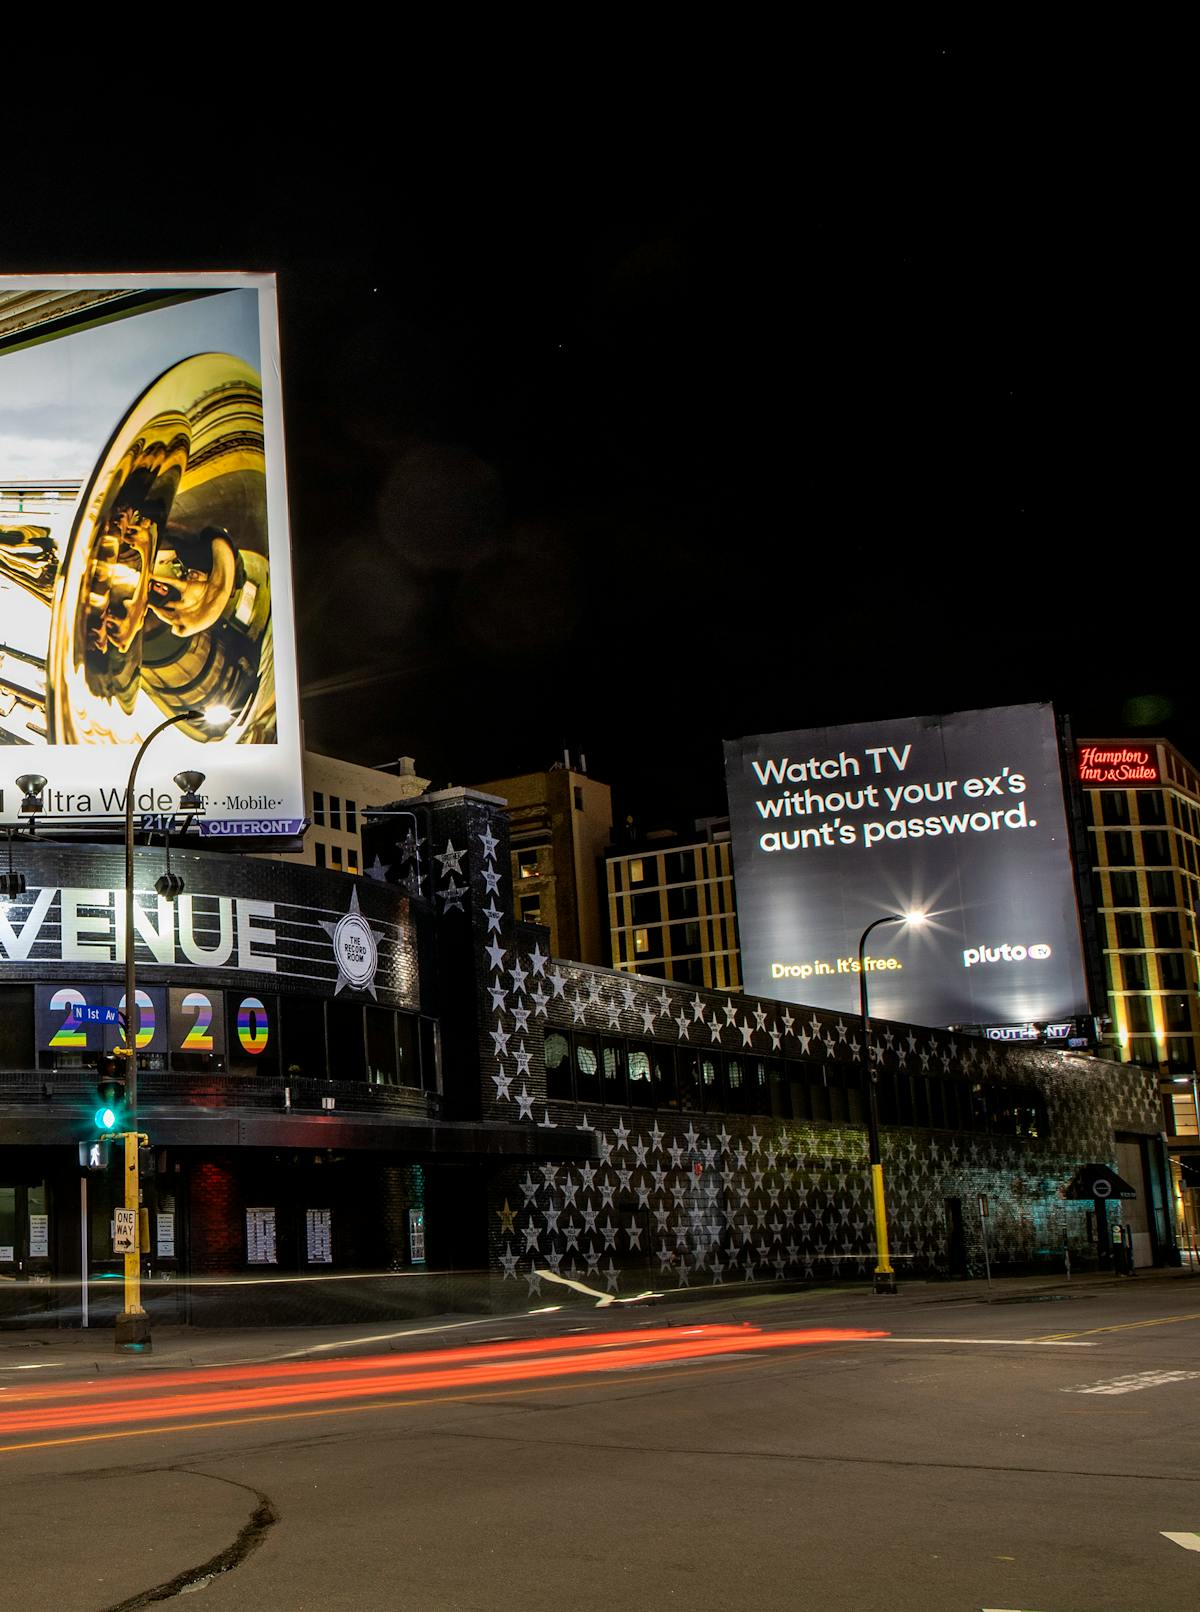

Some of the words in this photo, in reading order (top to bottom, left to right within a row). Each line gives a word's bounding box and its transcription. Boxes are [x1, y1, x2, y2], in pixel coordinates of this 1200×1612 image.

[1080, 747, 1149, 767] Hampton
[752, 752, 860, 786] Watch
[865, 744, 912, 773] TV
[1080, 766, 1107, 781] Inn
[1108, 769, 1117, 781] &
[1116, 765, 1157, 780] Suites
[41, 788, 92, 812] ltra
[756, 784, 879, 819] without
[884, 779, 957, 812] your
[963, 767, 1026, 798] ex's
[143, 815, 173, 830] 217
[208, 820, 293, 834] OUTFRONT
[759, 818, 856, 852] aunt's
[863, 801, 1037, 848] password.
[350, 936, 361, 945] THE
[344, 944, 367, 955] RECORD
[347, 952, 364, 962] ROOM
[963, 943, 1027, 967] pluto
[771, 963, 812, 979] Drop
[814, 960, 835, 975] in.
[837, 957, 861, 973] It's
[864, 956, 902, 971] free.
[76, 1008, 82, 1018] N
[87, 1008, 100, 1019] 1st
[106, 1010, 115, 1021] Av
[117, 1212, 133, 1223] ONE
[116, 1225, 133, 1235] WAY
